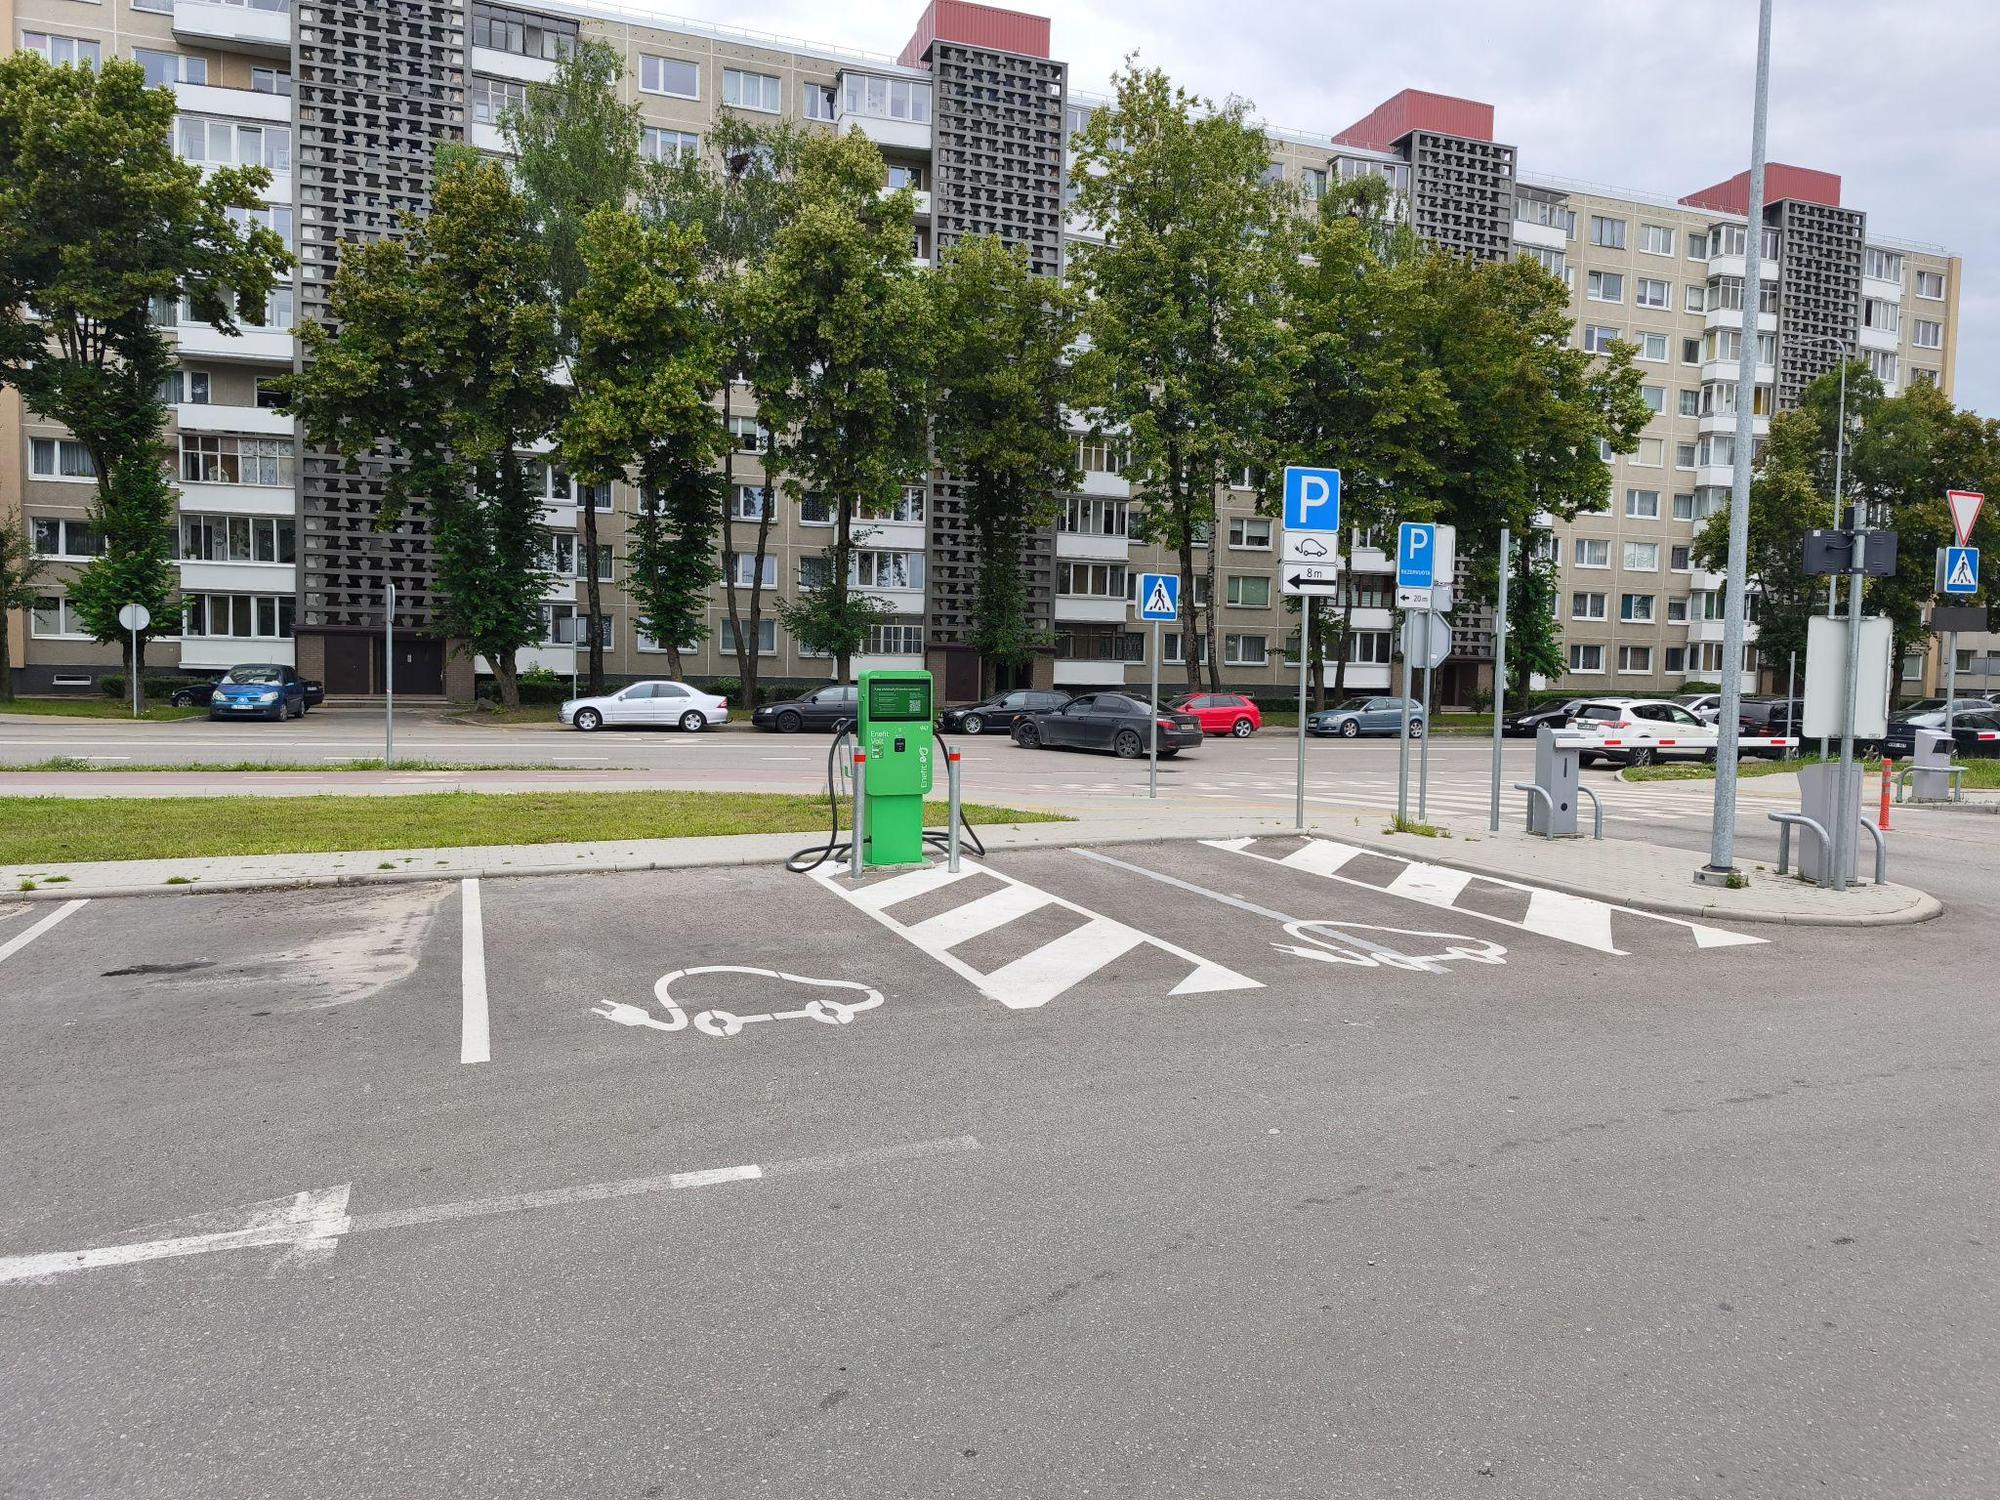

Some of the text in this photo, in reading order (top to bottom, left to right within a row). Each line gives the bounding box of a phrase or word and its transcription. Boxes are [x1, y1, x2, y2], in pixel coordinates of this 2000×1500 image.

[1300, 475, 1330, 523] P
[1409, 528, 1428, 559] P
[1400, 568, 1431, 576] REZERVUOTA
